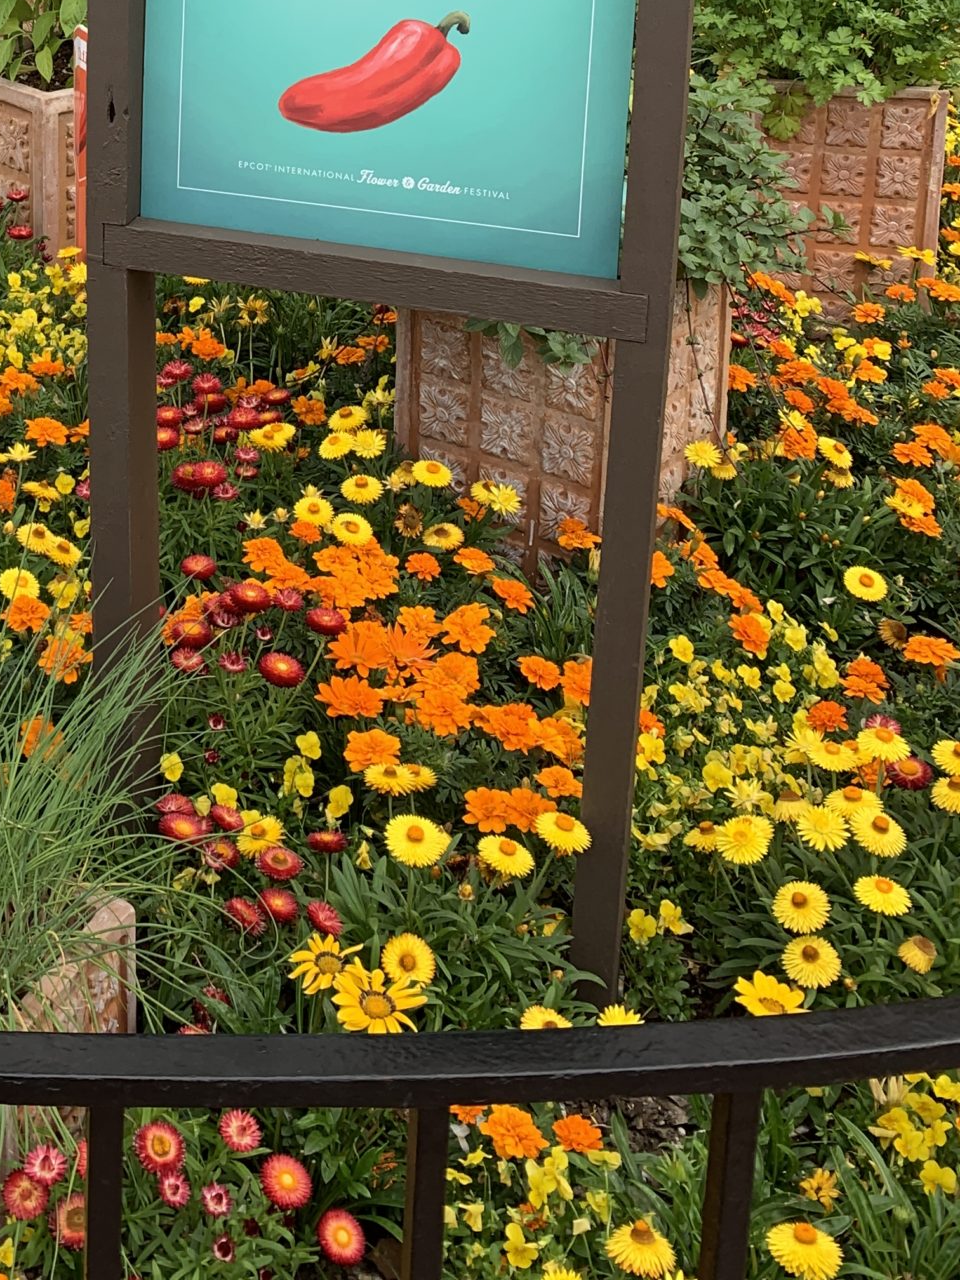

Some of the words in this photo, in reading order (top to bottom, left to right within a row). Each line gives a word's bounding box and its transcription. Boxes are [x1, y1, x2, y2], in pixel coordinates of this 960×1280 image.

[274, 164, 355, 182] INTERNATIONAL
[356, 169, 399, 188] Flower
[417, 177, 462, 195] Garden
[463, 187, 511, 200] FESTIVAL
